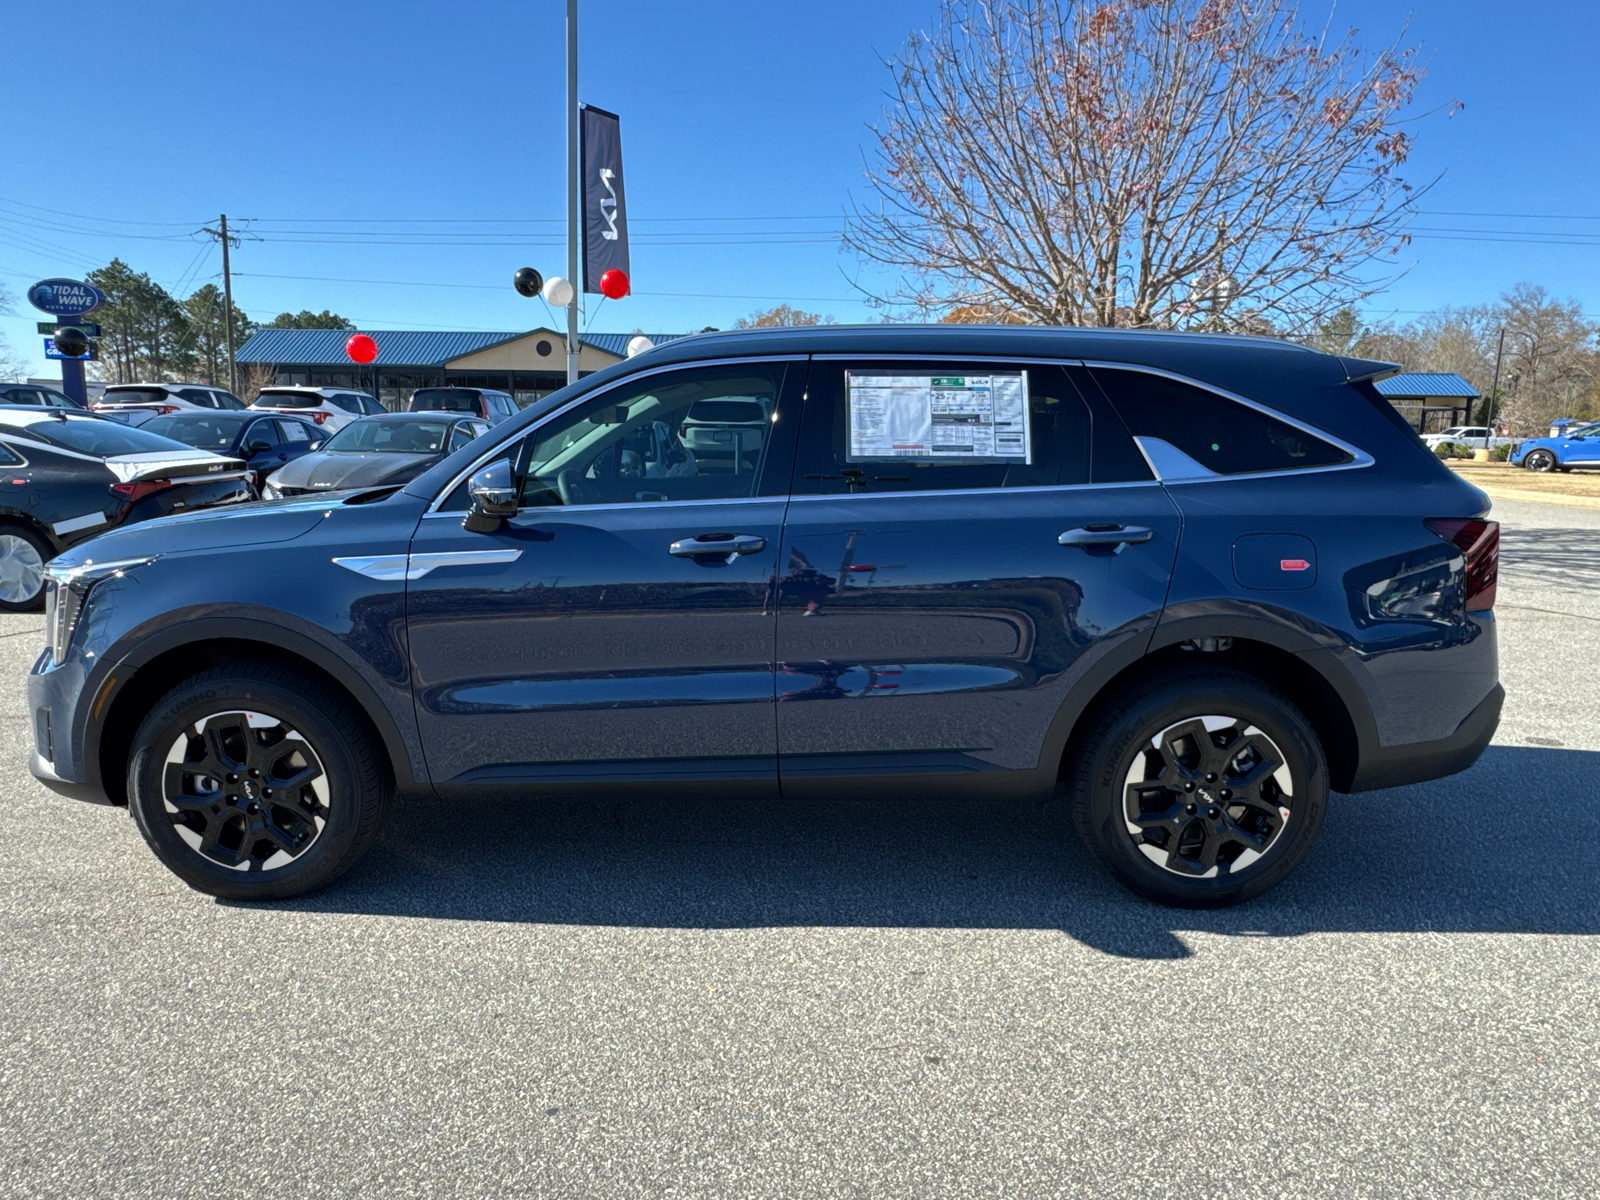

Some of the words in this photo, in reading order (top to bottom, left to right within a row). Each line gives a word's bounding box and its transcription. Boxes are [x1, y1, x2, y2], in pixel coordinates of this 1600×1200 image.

[52, 285, 86, 296] TIDAL
[58, 295, 93, 306] WAVE
[161, 689, 217, 723] KUMHO
[1101, 729, 1136, 787] KUMHO
